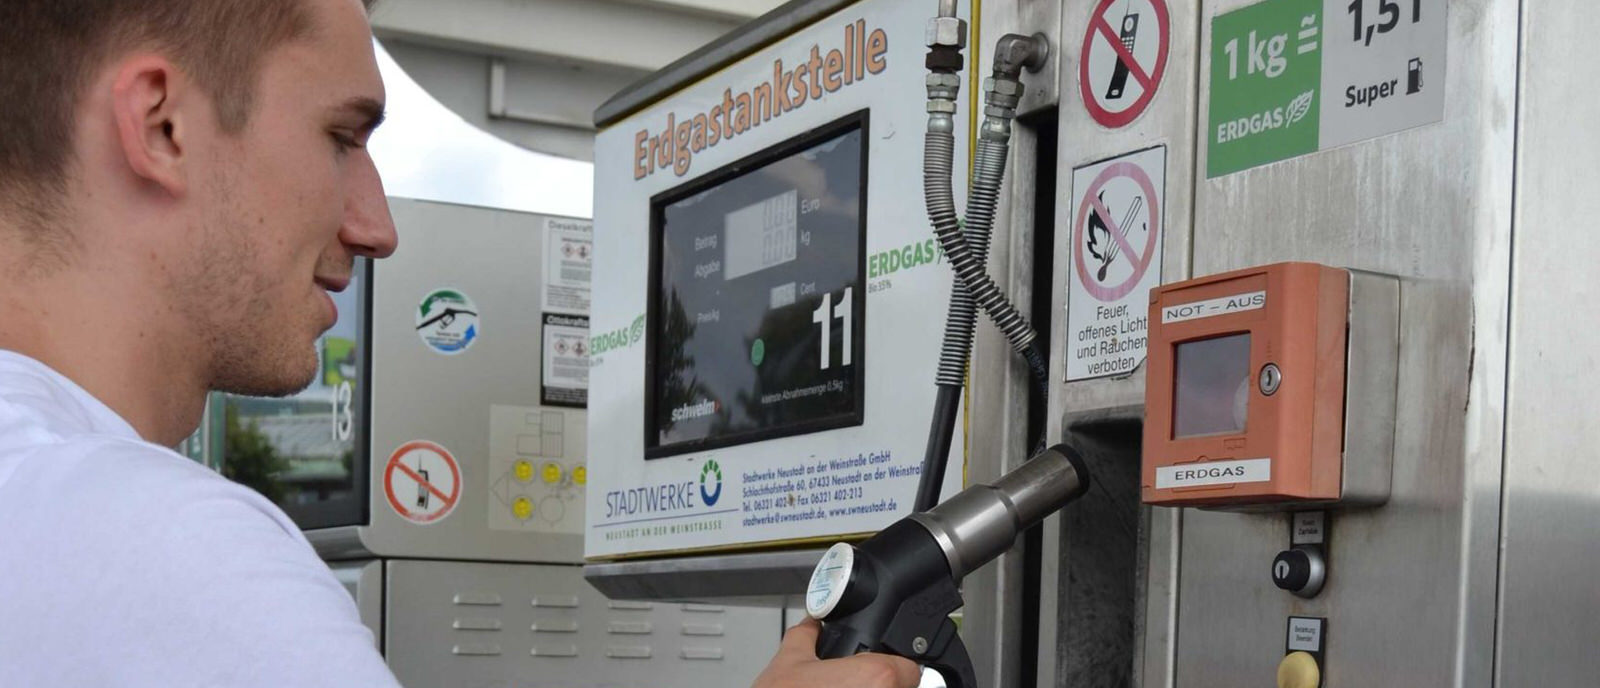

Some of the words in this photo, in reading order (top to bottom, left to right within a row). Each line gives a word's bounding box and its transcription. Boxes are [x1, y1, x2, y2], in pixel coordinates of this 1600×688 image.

[1247, 30, 1288, 78] kg
[633, 18, 888, 180] Erdgastankstelle
[1345, 78, 1398, 108] Super
[1217, 107, 1284, 144] ERDGAS
[800, 199, 821, 215] Euro
[694, 234, 719, 252] Betrag
[800, 230, 811, 247] kg
[693, 260, 721, 279] Abgabe
[868, 237, 934, 279] ERDGAS
[1097, 304, 1129, 321] Feuer,
[1166, 305, 1204, 320] NOT
[1225, 294, 1264, 310] AUS
[812, 286, 853, 370] 11
[1078, 324, 1118, 341] offenes
[1120, 315, 1147, 334] Licht
[590, 327, 628, 356] ERDGAS
[1077, 343, 1097, 359] und
[1100, 336, 1147, 355] Rauchen
[1088, 356, 1135, 374] verboten
[332, 380, 352, 442] 13
[671, 399, 716, 421] schwelm
[742, 468, 776, 484] Stadtwerke
[777, 464, 805, 479] Neustadt
[806, 465, 815, 475] an
[816, 460, 828, 474] der
[829, 453, 867, 471] Weinstraße
[868, 450, 891, 465] GmbH
[1174, 465, 1246, 481] ERDGAS
[742, 480, 795, 498] Schlachthofstraße
[808, 475, 830, 489] 67433
[831, 471, 863, 486] Neustadt
[863, 471, 873, 482] an
[873, 467, 886, 481] der
[606, 481, 694, 518] STADTWERKE
[742, 500, 753, 512] Tel.
[753, 498, 773, 511] 06321
[797, 494, 809, 506] Fax
[810, 491, 831, 505] 06321
[834, 487, 863, 501] 402-213
[829, 498, 897, 517] www.swneustadt.de
[605, 528, 639, 541] NEUSTADT
[642, 527, 651, 538] AN
[653, 525, 667, 537] DER
[670, 519, 722, 534] WEINSTRASSE
